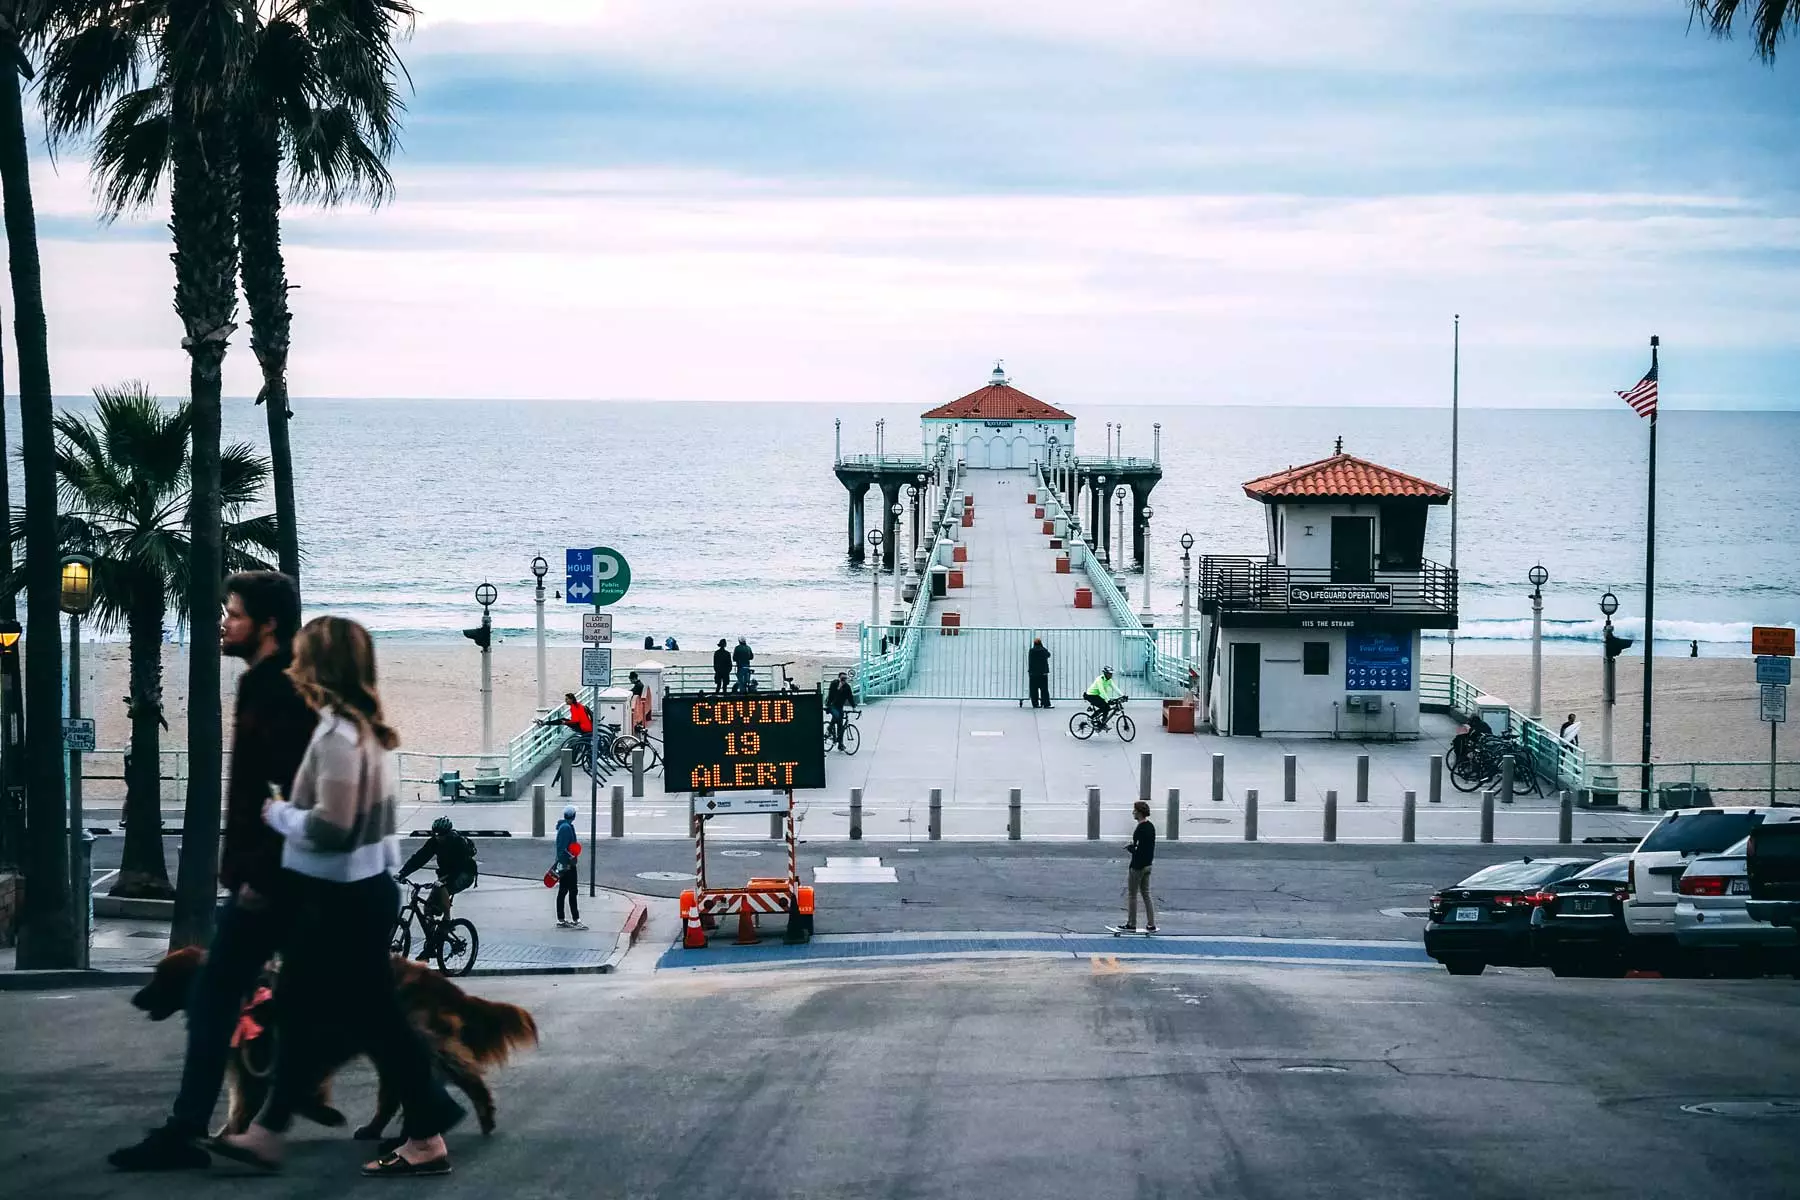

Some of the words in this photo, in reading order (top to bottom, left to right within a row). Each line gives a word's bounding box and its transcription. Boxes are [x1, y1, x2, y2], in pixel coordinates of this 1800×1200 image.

[568, 564, 591, 572] HOUR
[577, 552, 582, 560] 5
[593, 554, 619, 593] P
[1310, 591, 1347, 599] LIFEGUARD
[1347, 591, 1389, 599] OPERATIONS
[692, 700, 794, 725] COVID
[724, 732, 760, 756] 19
[691, 761, 799, 788] ALERT
